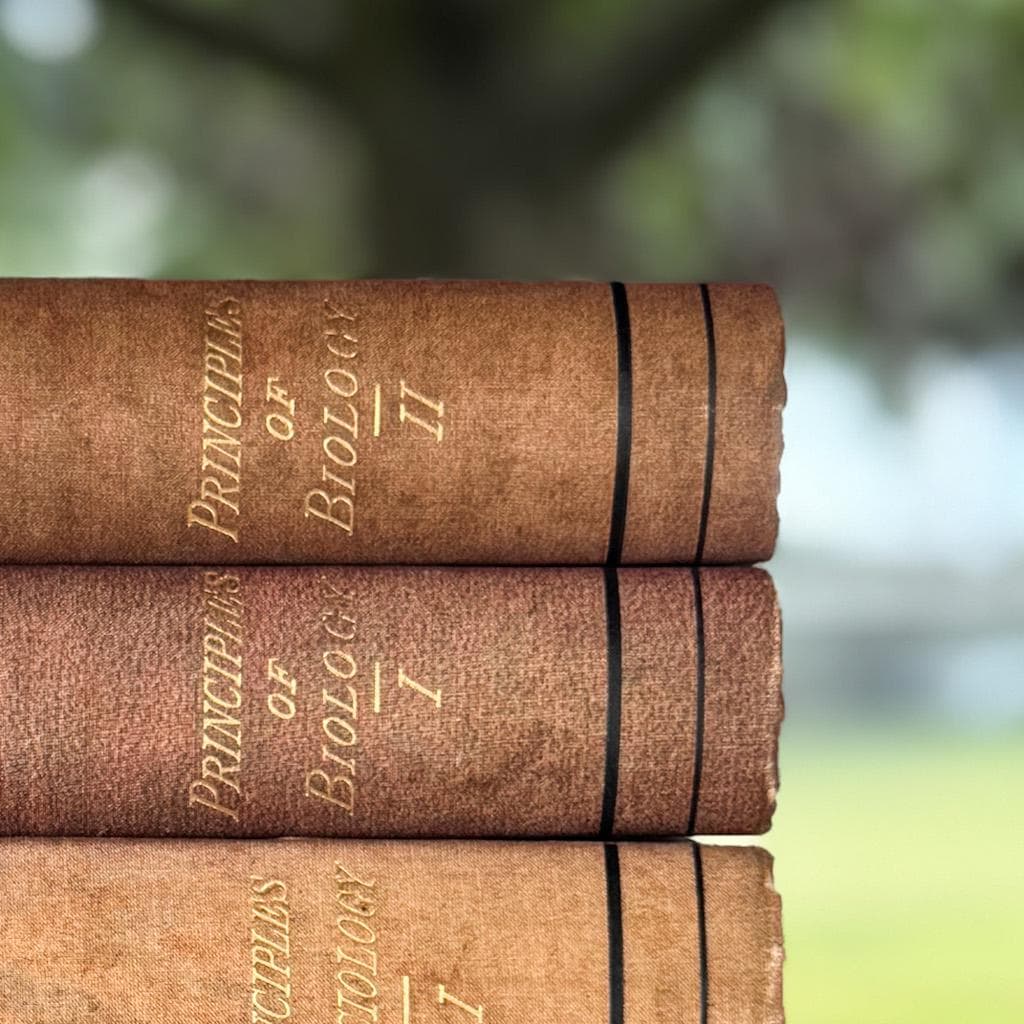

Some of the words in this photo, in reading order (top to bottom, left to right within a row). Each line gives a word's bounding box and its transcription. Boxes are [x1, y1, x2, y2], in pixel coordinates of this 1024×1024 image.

[187, 297, 242, 543] PRINCIPLES
[266, 376, 295, 442] OF
[305, 298, 359, 536] BIOLOGY
[399, 379, 444, 442] II
[188, 571, 243, 822] PRINCIPLES
[267, 657, 296, 720] OF
[305, 575, 357, 816] BIOLOGY
[398, 668, 441, 708] I
[438, 984, 483, 1024] I
